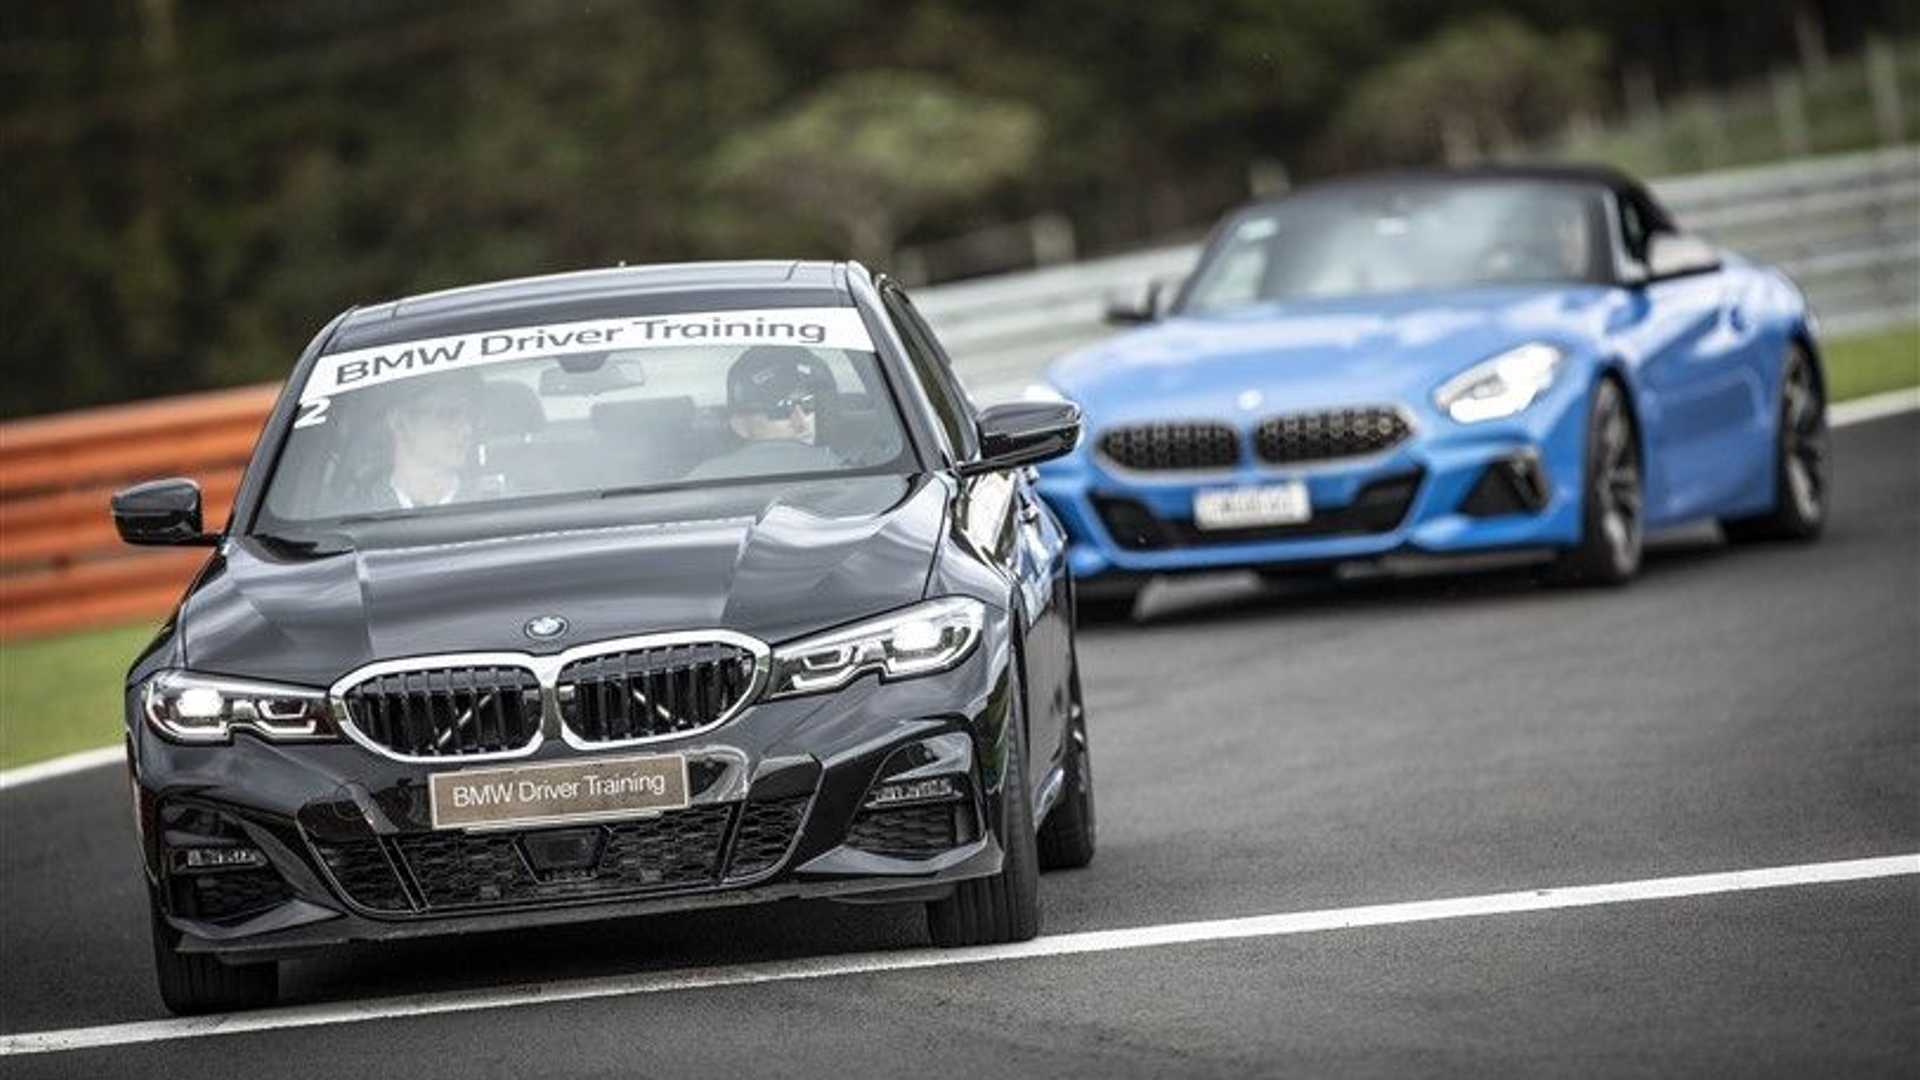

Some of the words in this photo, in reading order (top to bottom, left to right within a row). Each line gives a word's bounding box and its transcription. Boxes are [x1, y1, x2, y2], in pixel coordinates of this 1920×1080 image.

[335, 341, 465, 386] BMW
[480, 327, 624, 357] Driver
[632, 317, 827, 343] Training
[294, 396, 332, 430] 2
[452, 783, 513, 808] BMW
[518, 780, 580, 802] Driver
[583, 772, 665, 796] Training
